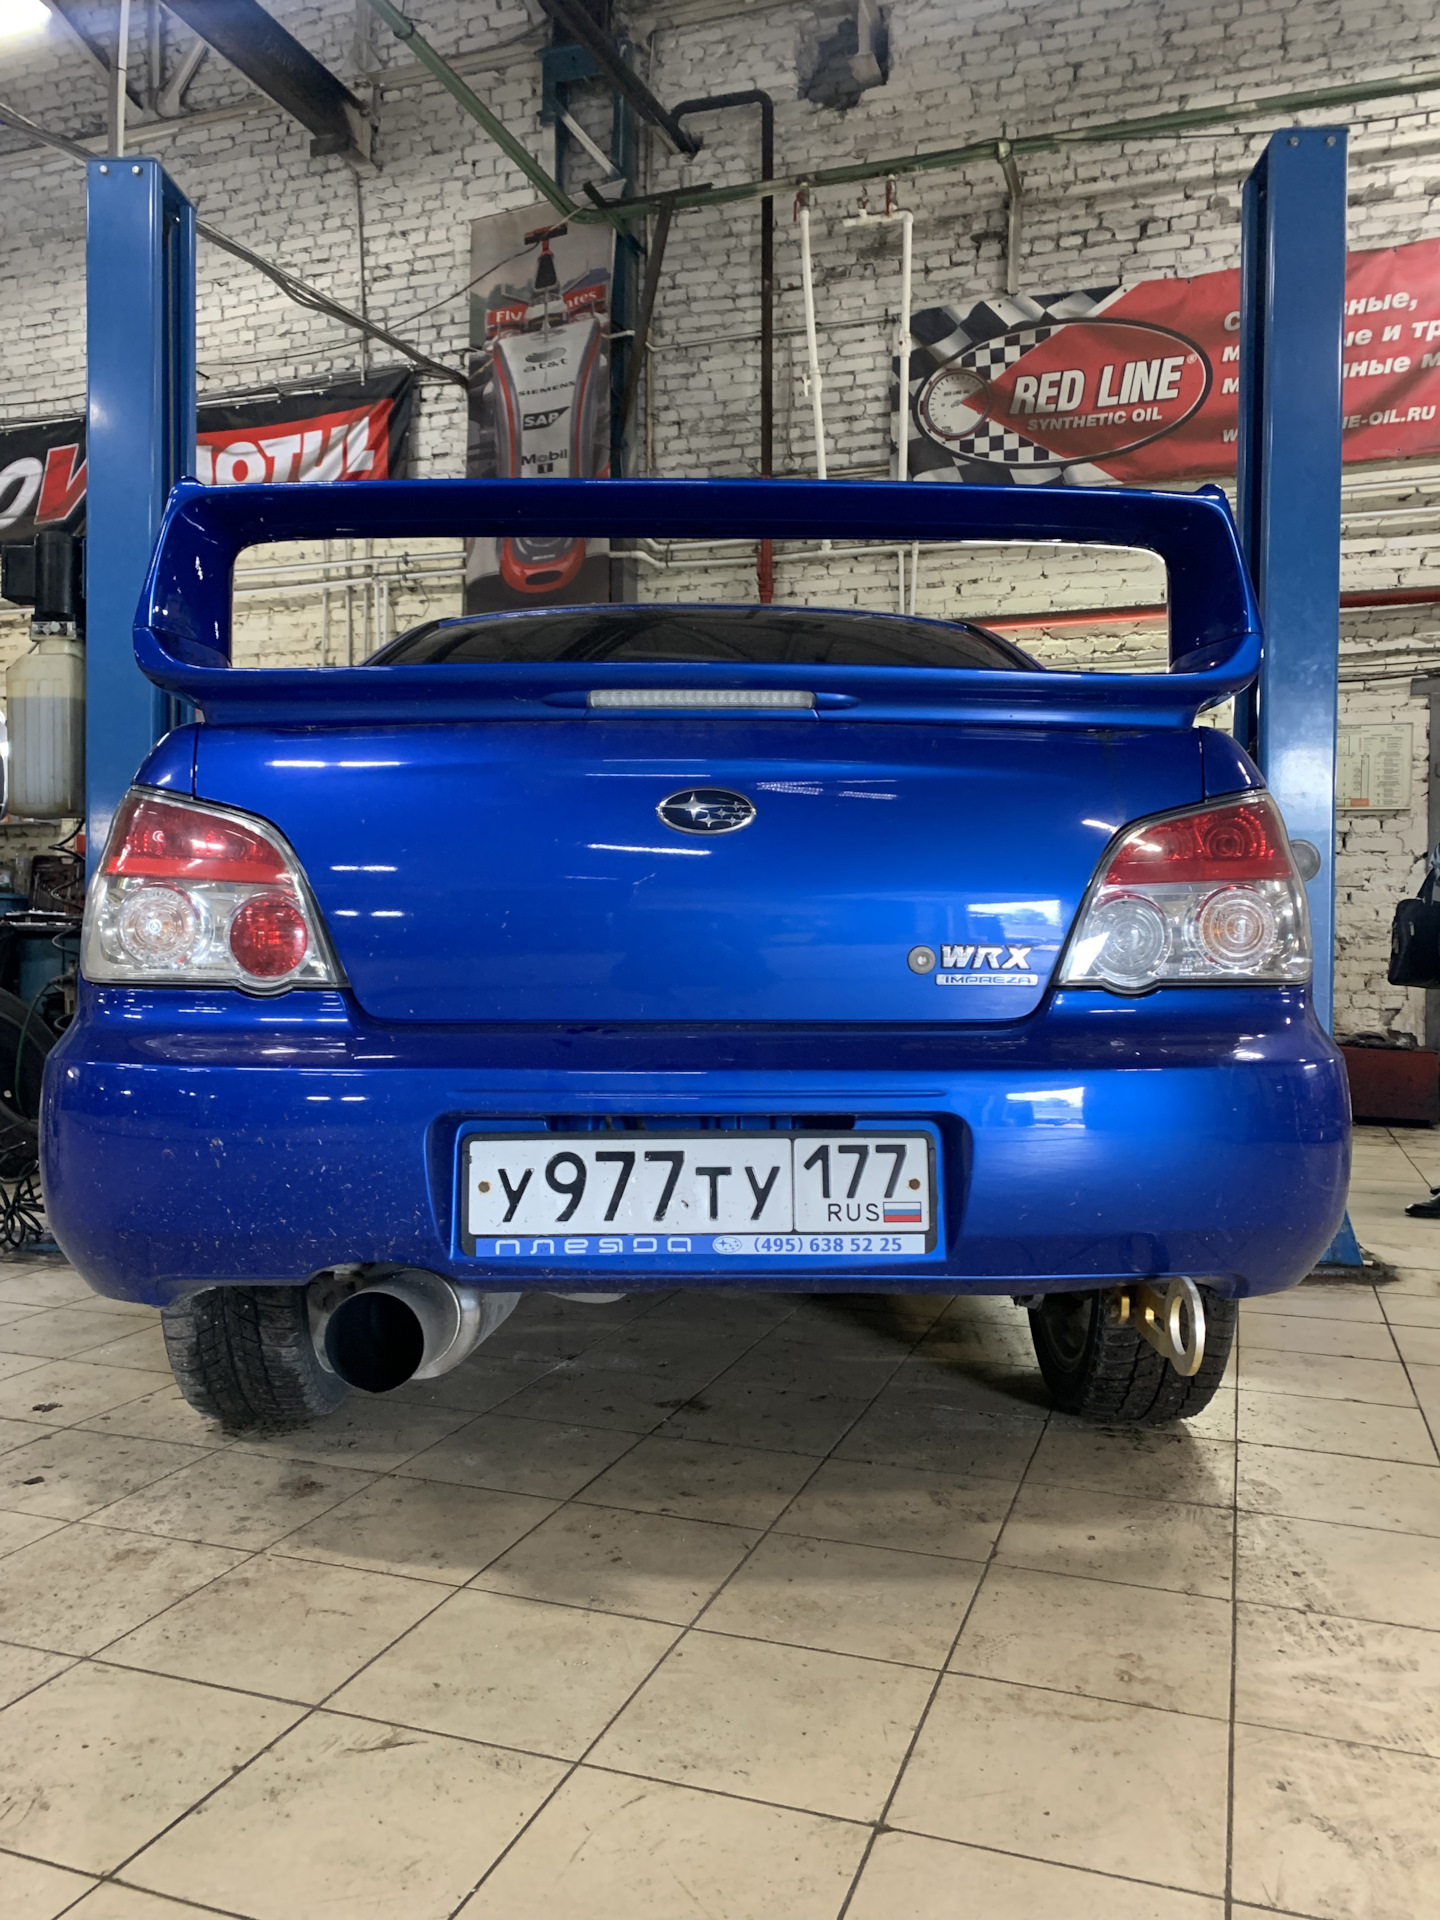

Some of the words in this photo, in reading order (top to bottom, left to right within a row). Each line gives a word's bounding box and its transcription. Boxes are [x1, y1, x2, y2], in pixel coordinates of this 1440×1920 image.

[518, 380, 576, 396] SIEMENS
[1009, 369, 1085, 415] RED
[1096, 355, 1185, 408] LINE
[524, 411, 561, 428] SAP
[1027, 411, 1126, 431] SYNTHETIC
[1132, 407, 1162, 422] OIL
[196, 416, 375, 484] OTUL
[521, 449, 568, 465] Mobil
[940, 944, 1034, 970] WRX
[945, 975, 1031, 984] IMPREZA
[803, 1144, 907, 1199] 177
[827, 1203, 880, 1222] RUS
[753, 1236, 803, 1253] (495)
[809, 1238, 844, 1252] 638
[850, 1238, 873, 1252] 52
[879, 1237, 902, 1252] 25
